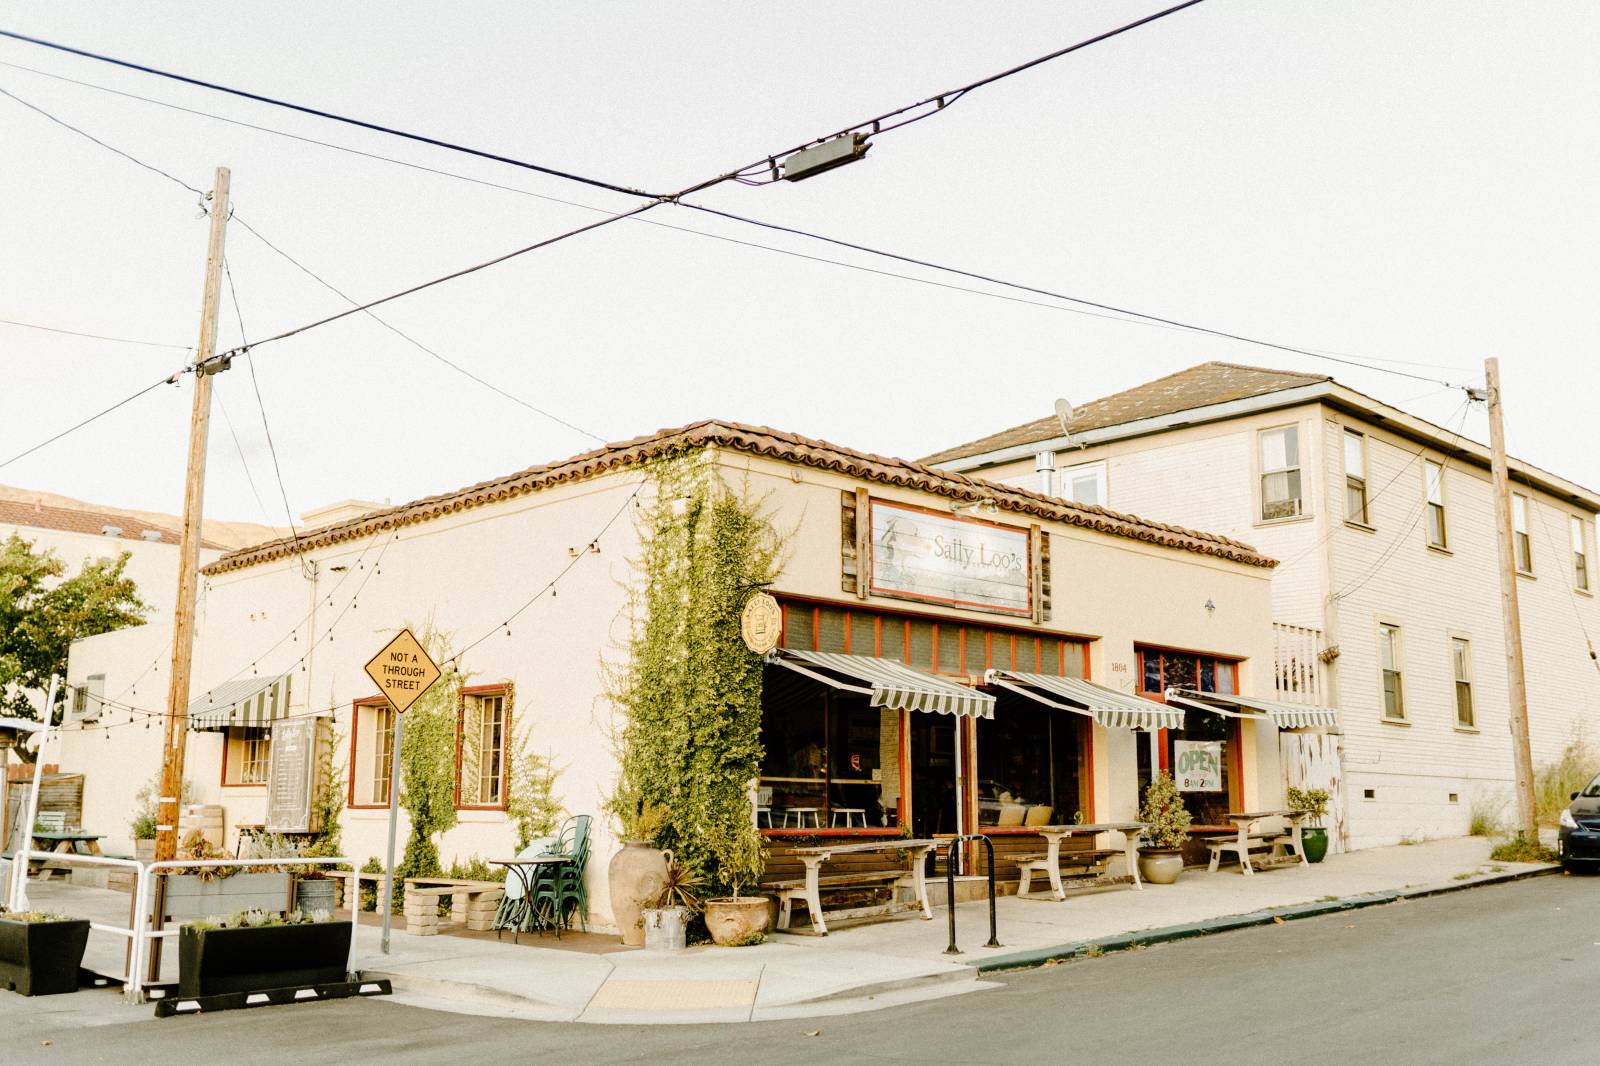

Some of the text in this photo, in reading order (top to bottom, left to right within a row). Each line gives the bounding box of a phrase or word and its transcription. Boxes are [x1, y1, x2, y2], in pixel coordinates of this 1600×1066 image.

[934, 534, 1022, 570] Sally Loo's
[390, 652, 418, 663] NOT A
[382, 664, 426, 678] THROUGH
[1111, 662, 1127, 673] 1804
[385, 678, 421, 690] STREET
[1178, 750, 1219, 777] OPEN
